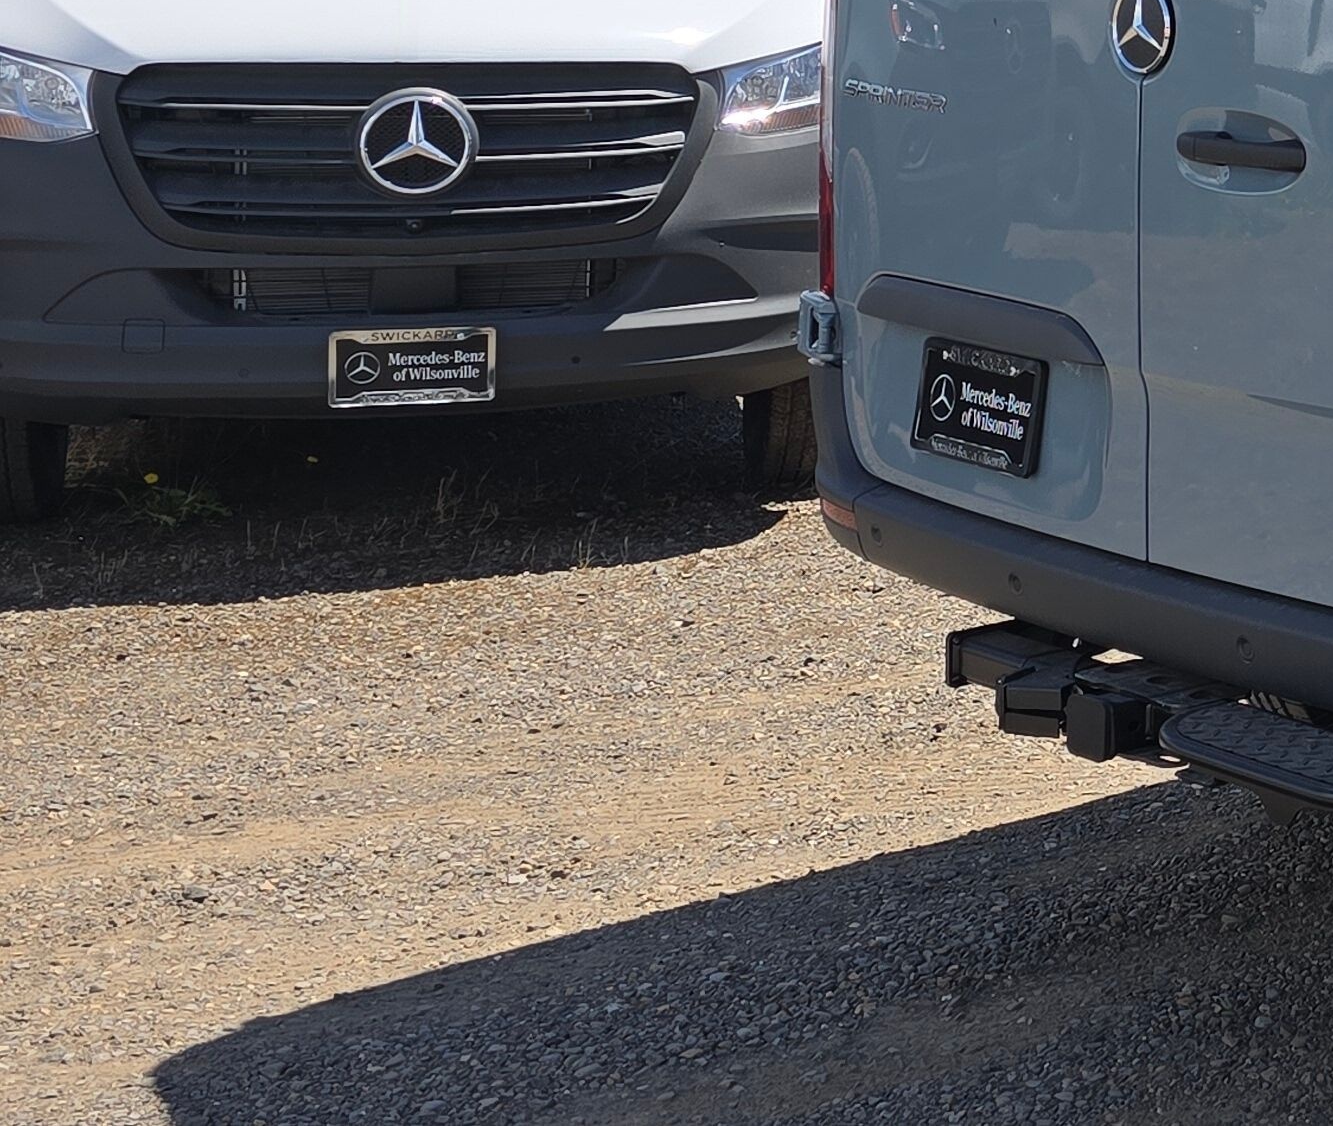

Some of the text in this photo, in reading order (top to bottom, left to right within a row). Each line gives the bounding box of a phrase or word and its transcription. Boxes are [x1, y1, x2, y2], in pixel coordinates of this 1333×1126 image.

[843, 78, 948, 114] SPRINTER
[387, 350, 486, 367] Mercedes-Benz
[392, 365, 481, 382] of Wilsonville
[960, 382, 1032, 418] Mercedes-Benz
[960, 408, 1024, 441] of Wilsonville
